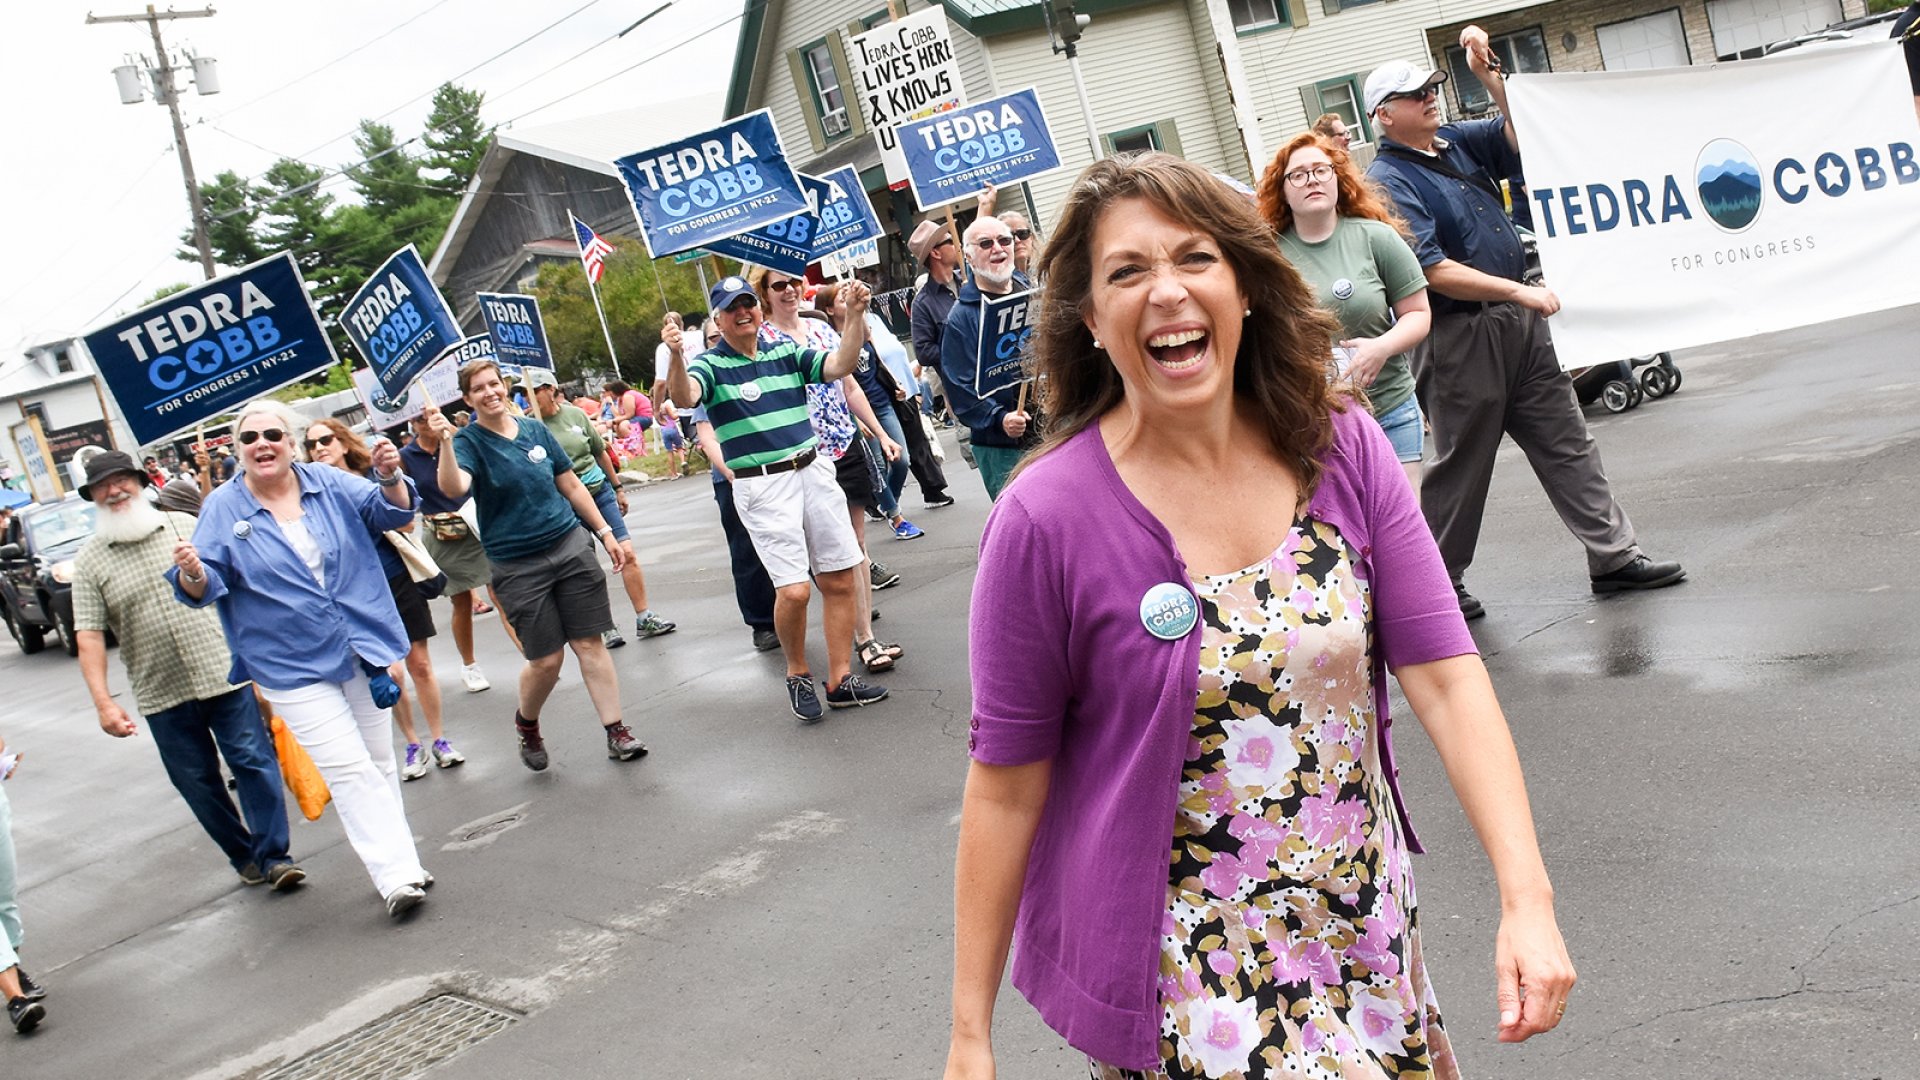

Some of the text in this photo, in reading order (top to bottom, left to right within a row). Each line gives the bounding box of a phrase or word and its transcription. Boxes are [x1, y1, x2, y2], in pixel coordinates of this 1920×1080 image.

[854, 25, 937, 66] TEDRA COBB
[862, 39, 953, 92] LIVES HERE
[869, 70, 952, 127] & KNOWS
[879, 121, 902, 151] U
[918, 103, 1024, 151] TEDRA
[637, 131, 758, 192] TEDRA
[934, 128, 1026, 173] COBB
[936, 178, 955, 188] FOR
[957, 163, 1002, 183] CONGRESS
[1011, 154, 1036, 167] NY-21
[659, 163, 764, 217] COBB
[1533, 141, 1920, 239] TEDRA COBB
[668, 225, 688, 236] FOR
[689, 207, 740, 230] CONGRESS
[749, 194, 778, 210] NY-21
[767, 215, 811, 244] BB
[780, 246, 807, 261] NY-21
[1671, 235, 1817, 272] FOR CONGRESS
[117, 280, 276, 363] TEDRA
[350, 272, 412, 342] TEDRA
[148, 315, 281, 391] COBB
[369, 301, 422, 365] COBB
[454, 339, 496, 363] TEDR
[995, 326, 1033, 360] CO
[156, 398, 182, 416] FOR
[184, 369, 250, 404] CONGRESS
[261, 348, 298, 370] NY-21
[987, 366, 1002, 378] FOR
[1146, 594, 1189, 618] TEDRA
[1152, 604, 1191, 627] COBB
